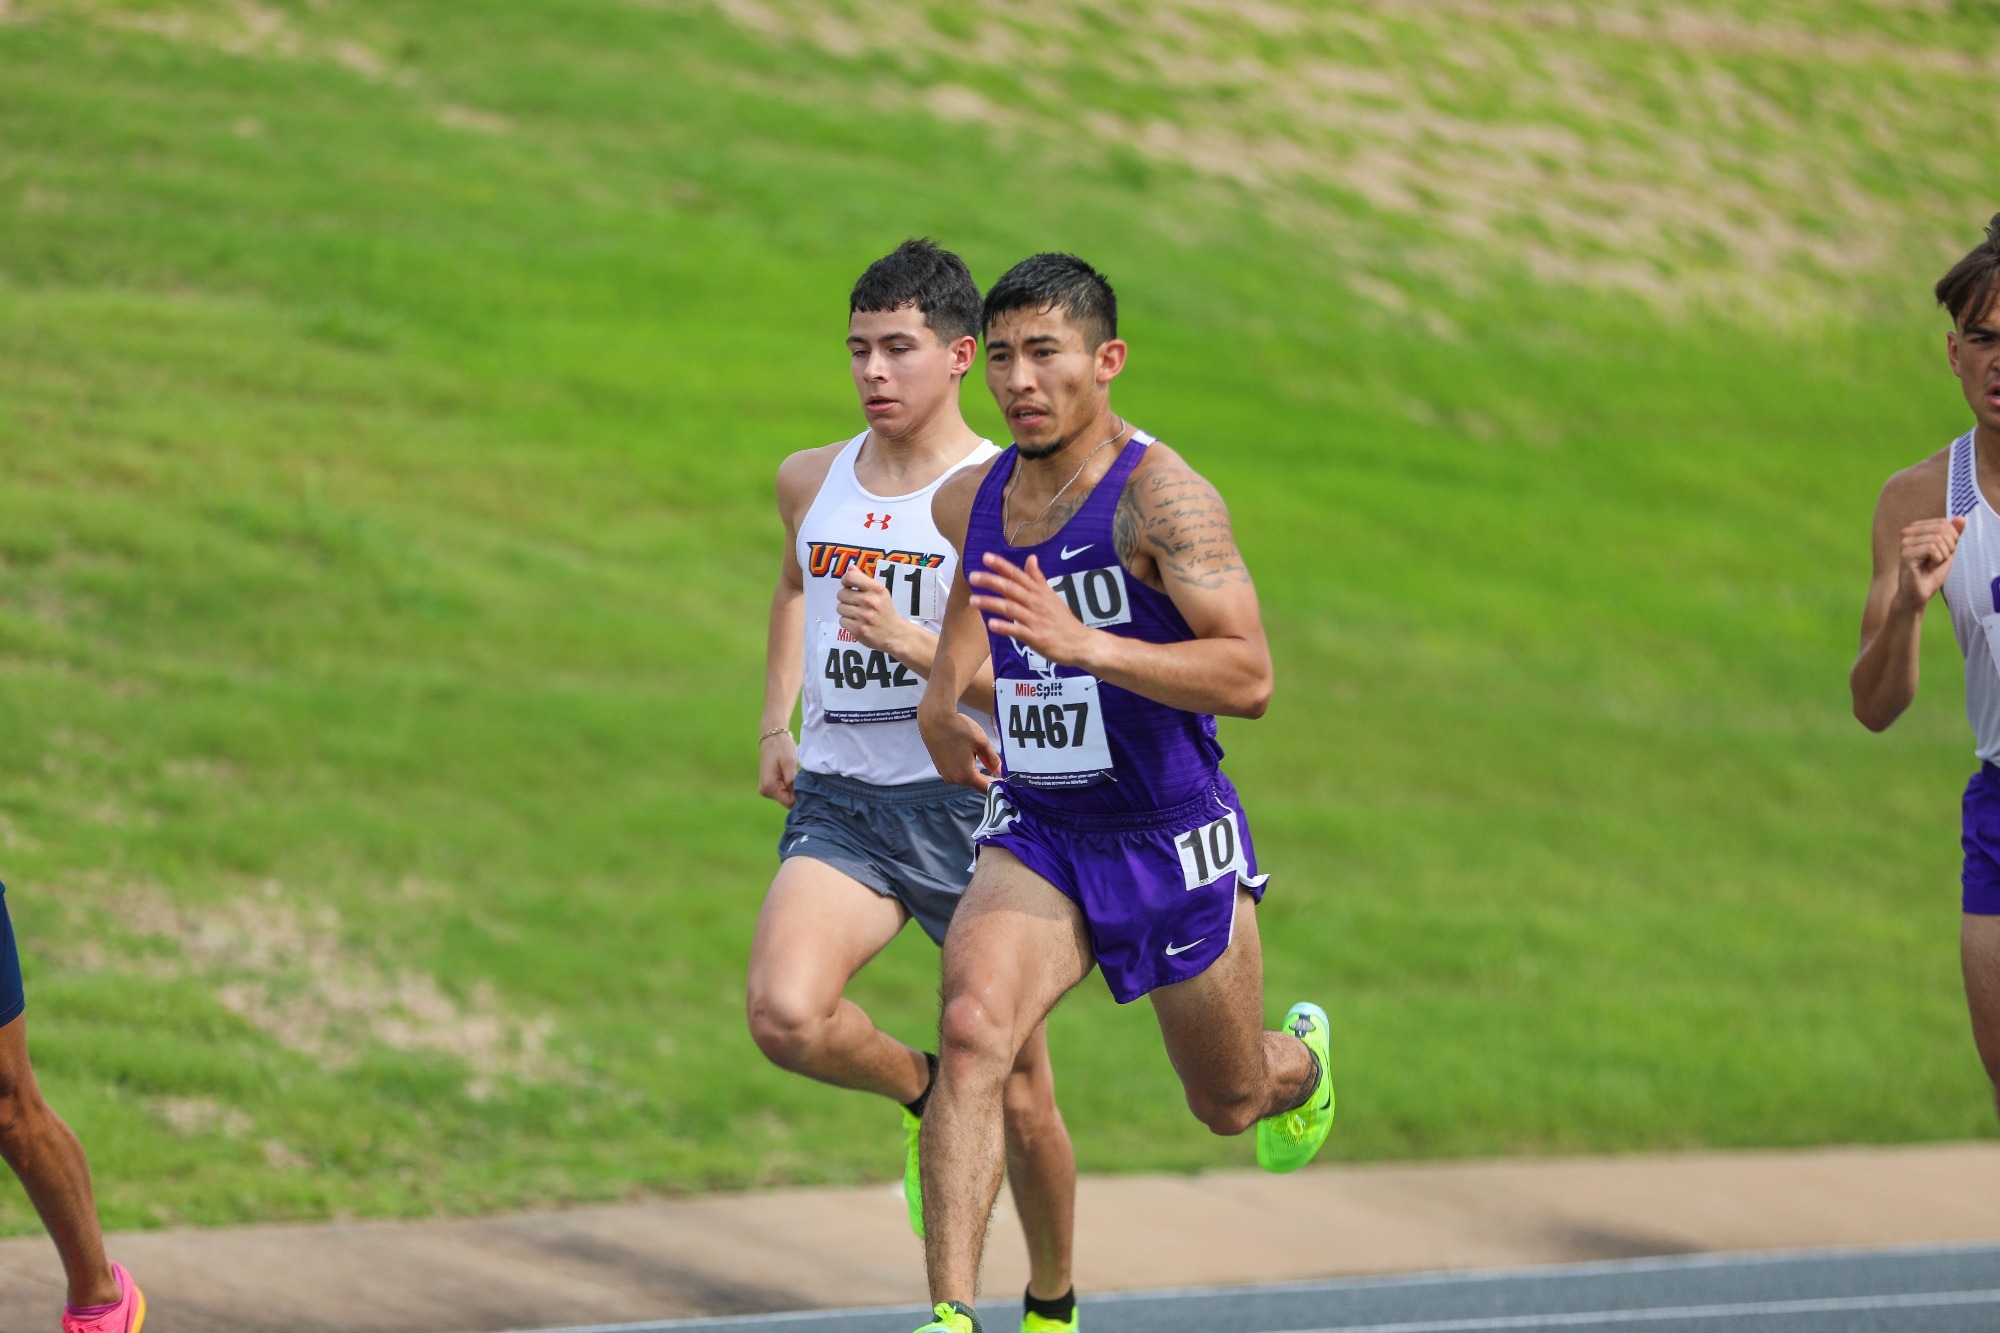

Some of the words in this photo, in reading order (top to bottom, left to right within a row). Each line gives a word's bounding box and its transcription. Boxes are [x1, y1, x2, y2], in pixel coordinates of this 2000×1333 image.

[879, 564, 922, 616] 11
[1052, 568, 1122, 624] 10
[825, 648, 918, 690] 4642
[1015, 683, 1063, 700] MileSplit
[1009, 702, 1088, 749] 4467
[1180, 817, 1235, 881] 10
